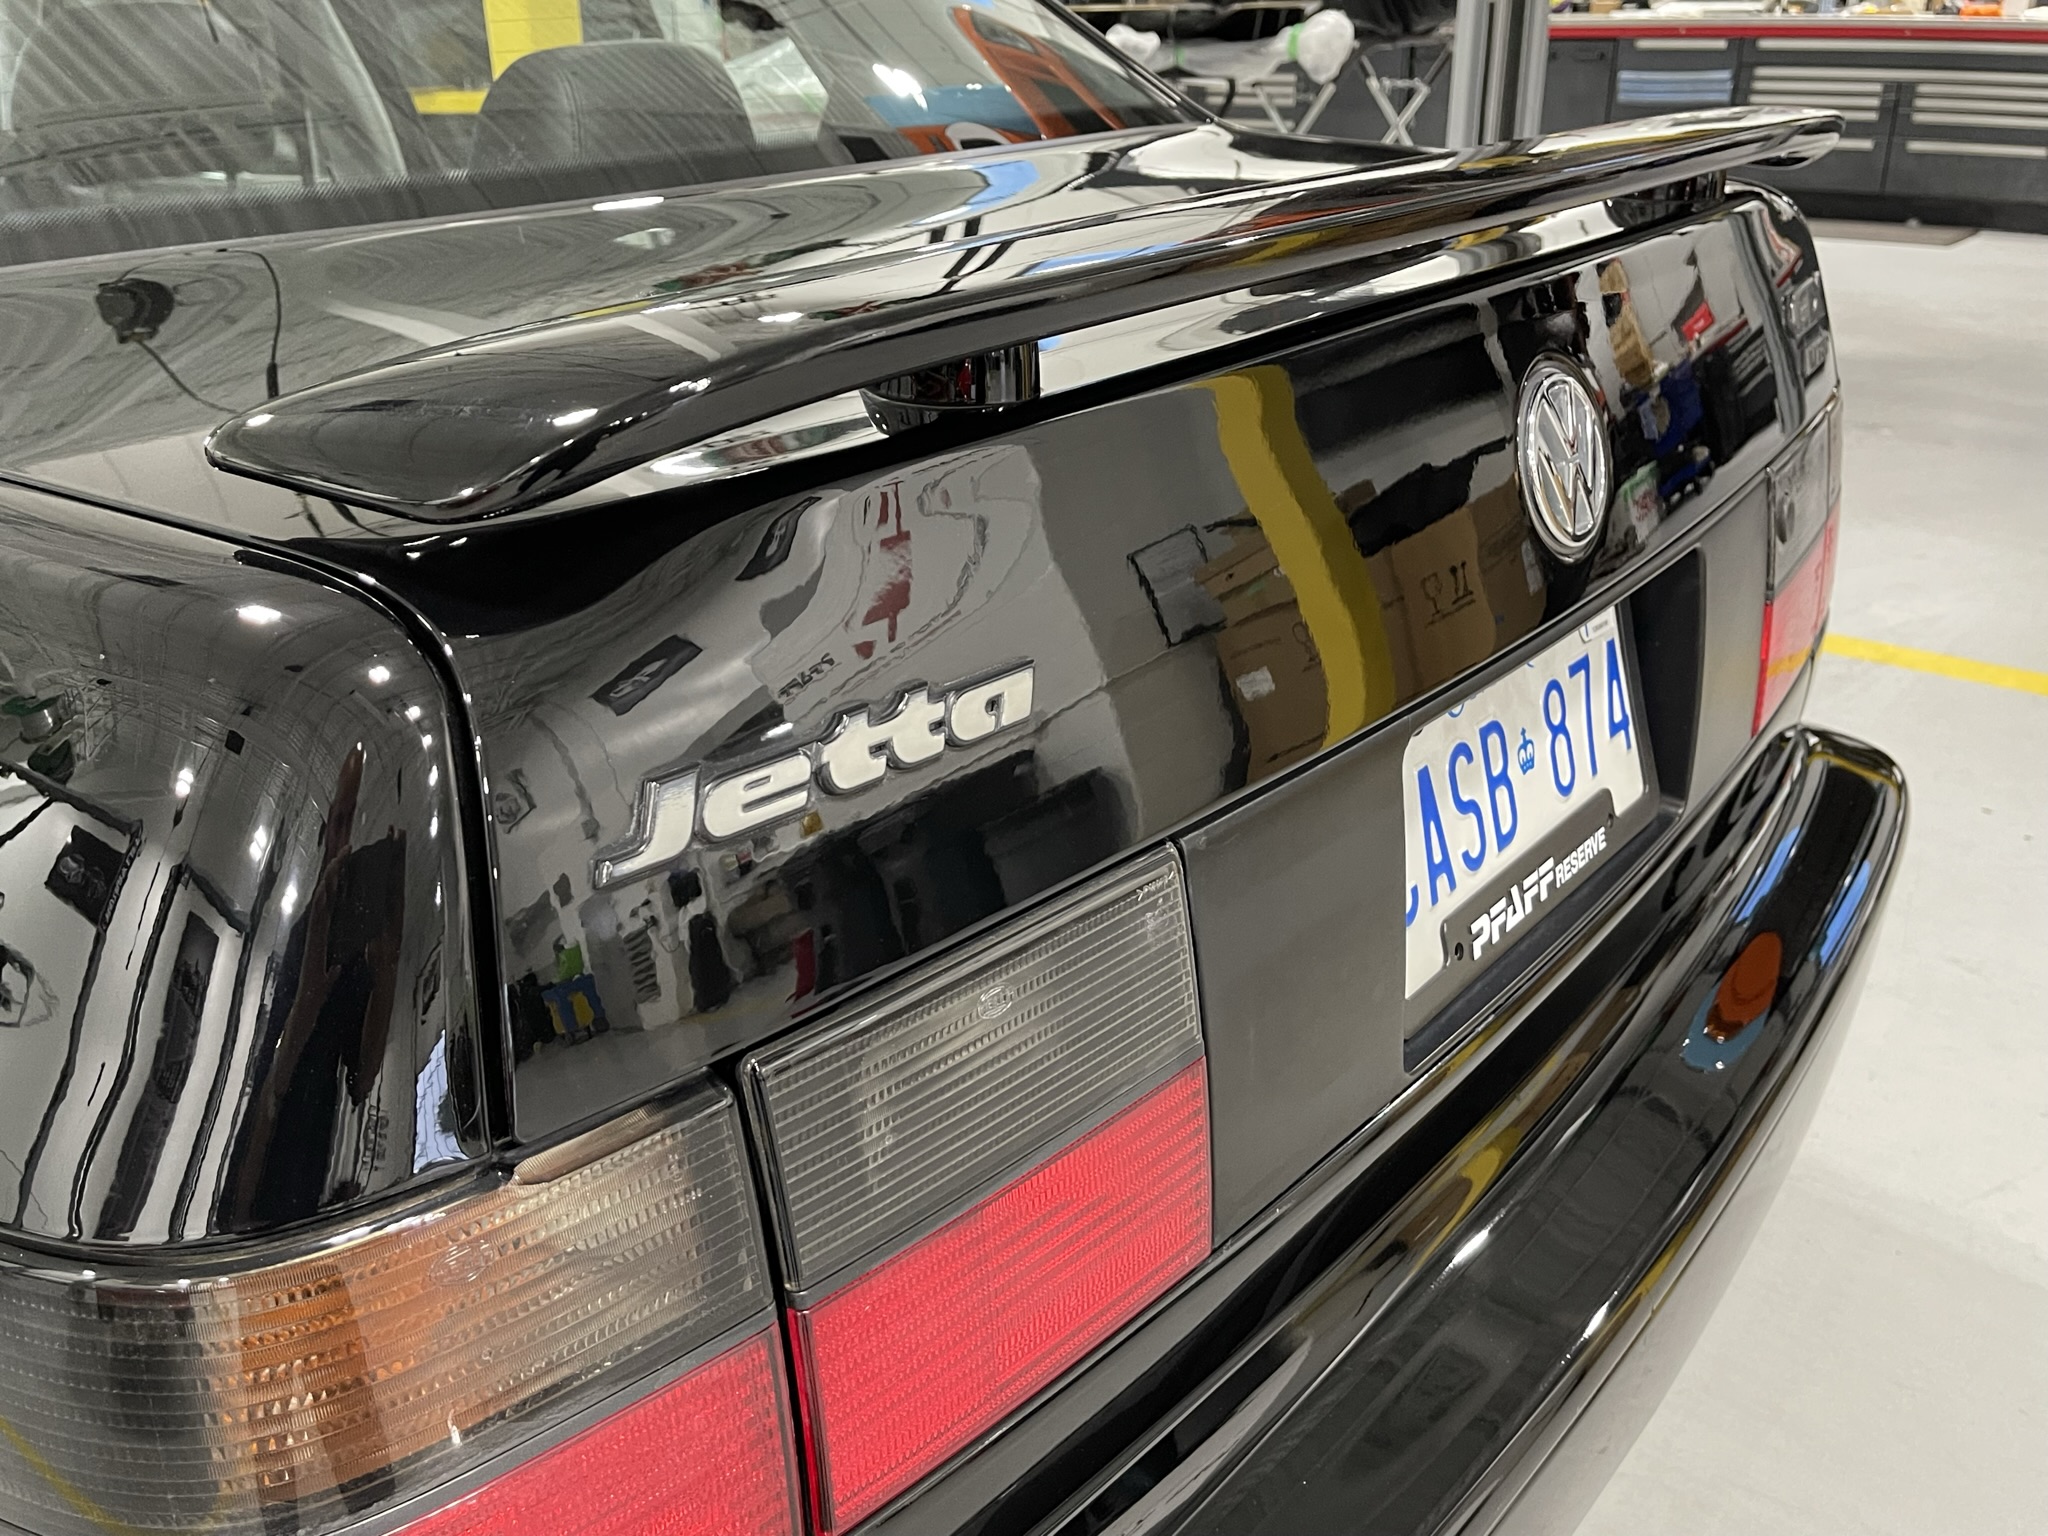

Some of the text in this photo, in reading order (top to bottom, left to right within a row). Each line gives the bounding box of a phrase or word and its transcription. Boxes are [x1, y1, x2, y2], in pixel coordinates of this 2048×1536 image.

[593, 660, 1035, 889] Jetta
[1542, 637, 1632, 797] 874
[1470, 826, 1607, 961] PFAFF RESERVE
